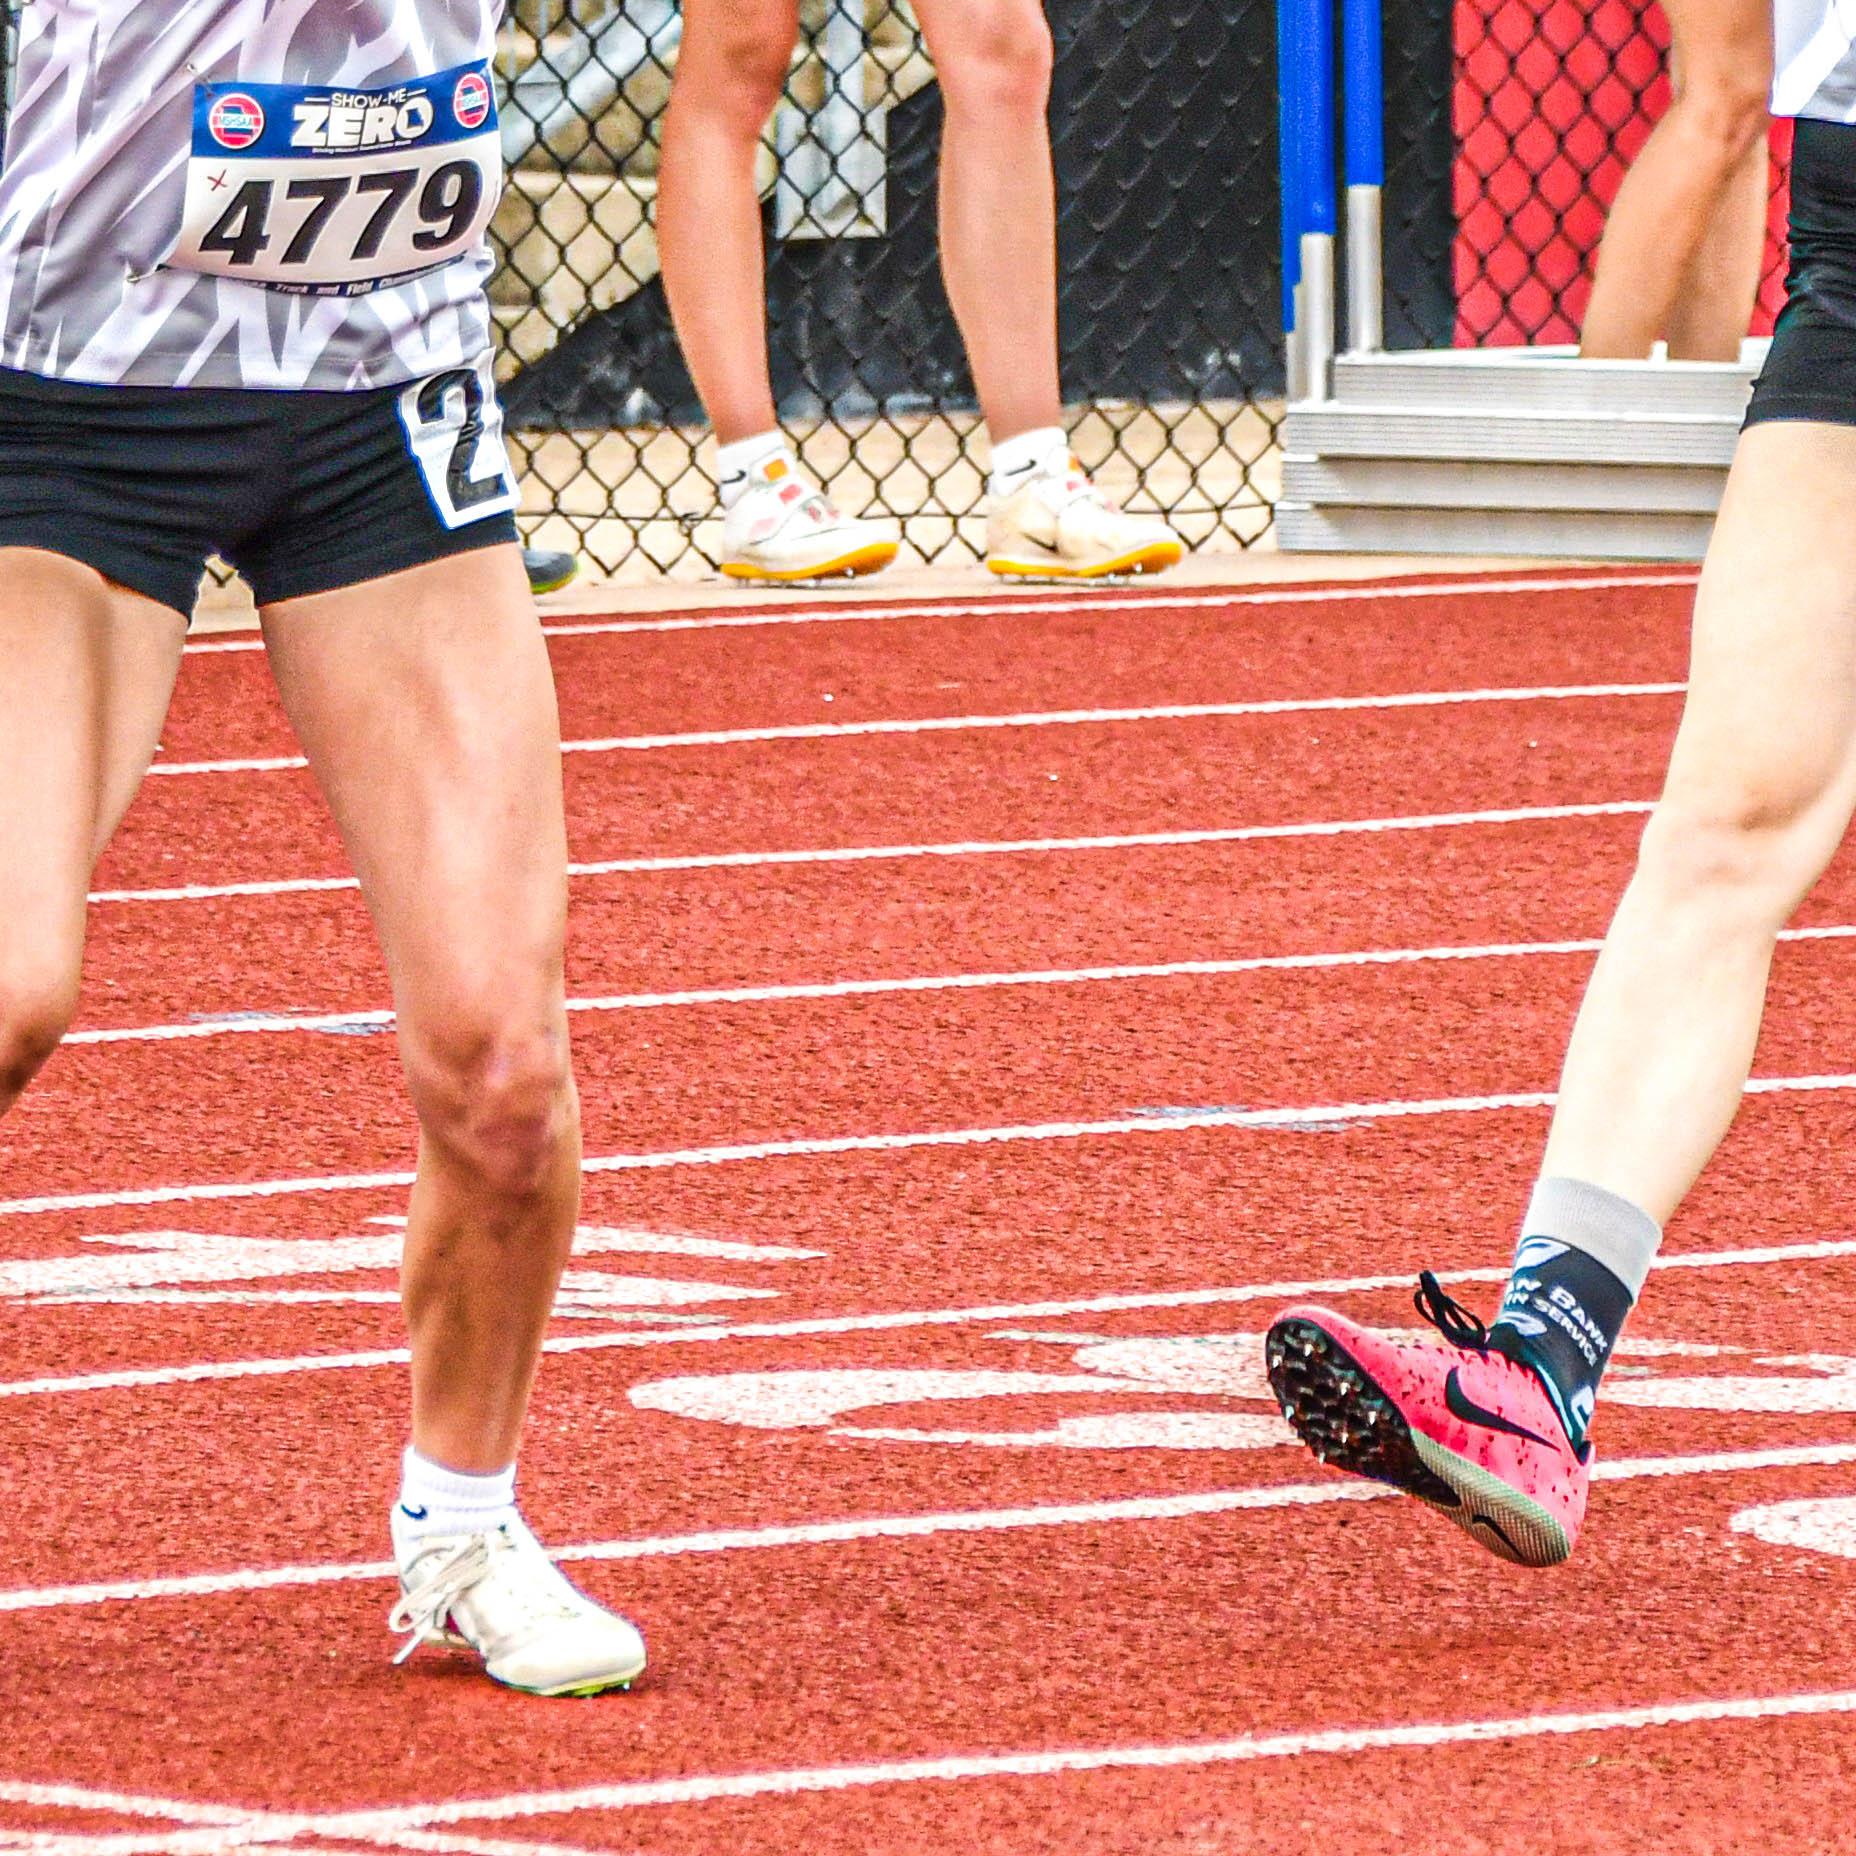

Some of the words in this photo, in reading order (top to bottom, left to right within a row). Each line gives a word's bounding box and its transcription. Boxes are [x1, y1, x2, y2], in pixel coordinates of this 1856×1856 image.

[290, 96, 434, 149] ZERO
[331, 88, 407, 108] SHOW-ME
[197, 157, 484, 266] 4779
[416, 367, 510, 513] 2
[1548, 1284, 1608, 1353] BANK
